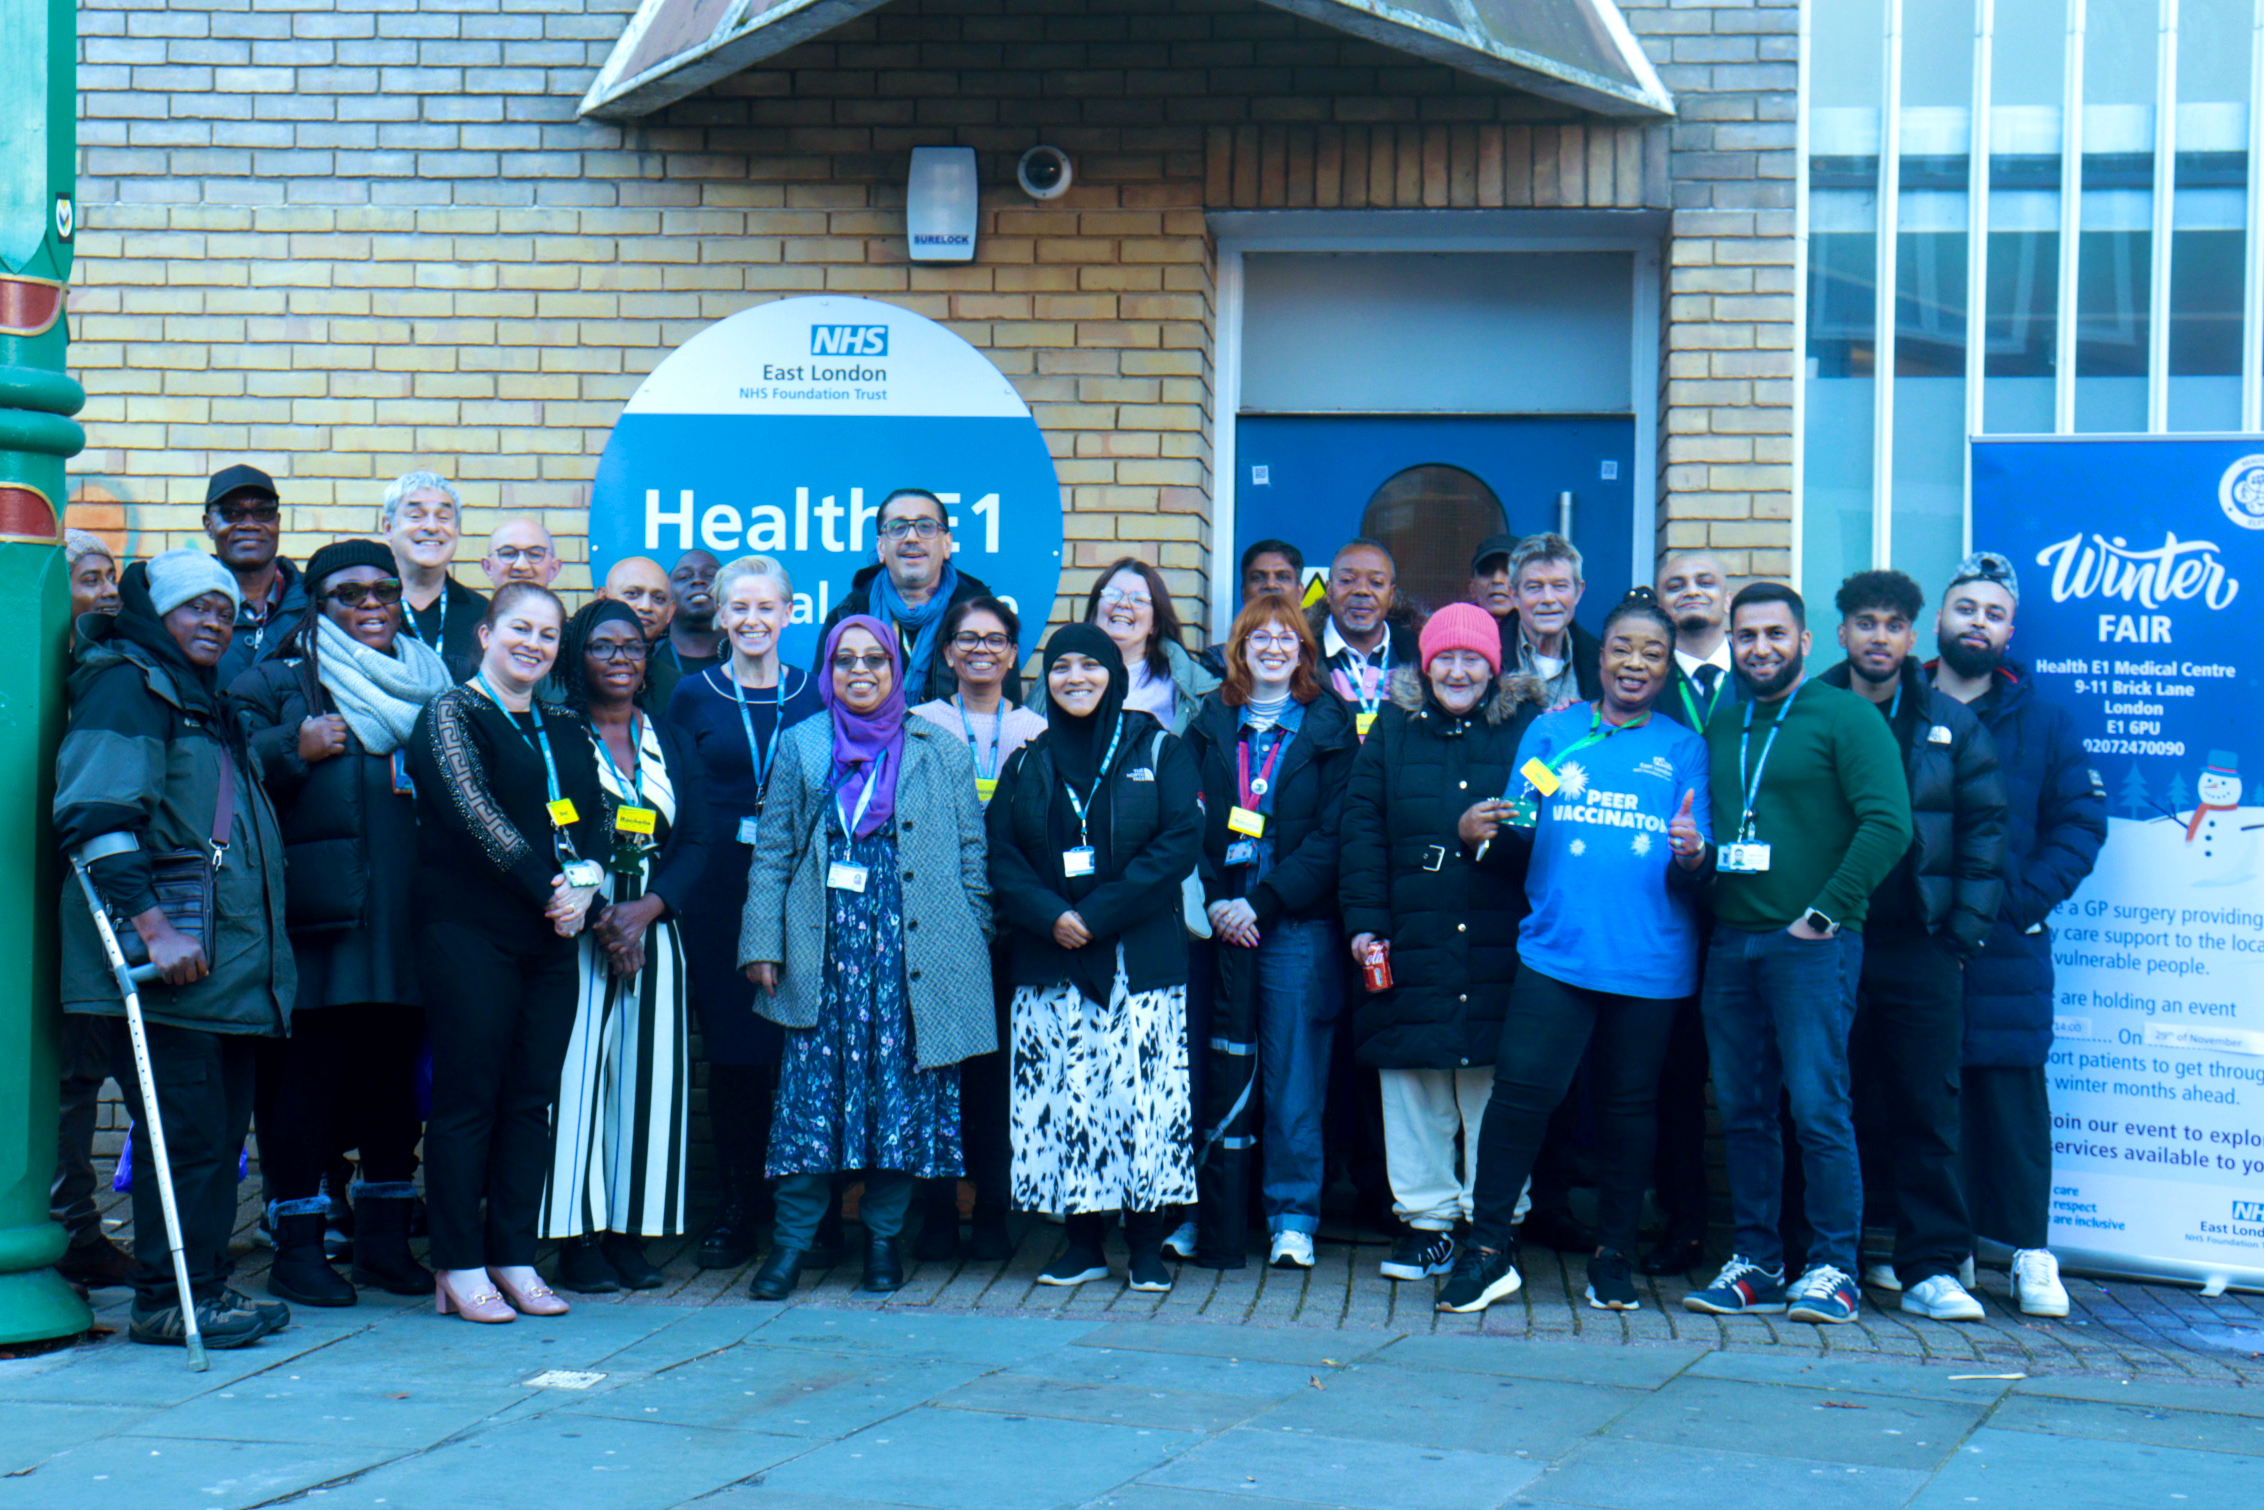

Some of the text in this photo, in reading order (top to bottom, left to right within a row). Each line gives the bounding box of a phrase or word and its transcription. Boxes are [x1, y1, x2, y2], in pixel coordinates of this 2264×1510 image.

[914, 234, 969, 245] SURELOCK
[812, 326, 887, 355] NHS
[763, 363, 887, 382] East London
[739, 387, 888, 400] NHS Foundation Trust
[645, 486, 880, 552] Health
[2035, 530, 2239, 610] Winter
[2098, 614, 2173, 644] FAIR
[2036, 658, 2236, 678] Health E1 Medical Centre
[2074, 679, 2195, 697] 9-11 Brick Lane
[2104, 699, 2164, 716] London
[2107, 719, 2161, 736] E1 6PU
[2083, 738, 2185, 757] 02072470090
[1586, 788, 1639, 811] PEER
[2068, 902, 2079, 915] a
[2084, 899, 2109, 917] GP
[2113, 903, 2177, 925] surgery
[2181, 907, 2263, 931] providing
[2064, 927, 2099, 942] care
[2104, 929, 2169, 949] support
[2175, 933, 2192, 949] to
[2198, 931, 2226, 951] the
[2054, 949, 2210, 978] vulnerable people.
[2060, 989, 2237, 1018] are holding an event
[2118, 1028, 2143, 1046] On
[2189, 1033, 2242, 1048] November
[2079, 1052, 2147, 1072] patients
[2152, 1058, 2170, 1073] to
[2175, 1061, 2203, 1080] get
[2054, 1074, 2241, 1106] winter months ahead.
[2088, 1118, 2119, 1134] our
[2125, 1121, 2177, 1139] event
[2184, 1125, 2203, 1141] to
[2124, 1146, 2209, 1168] available
[2216, 1153, 2236, 1170] to
[2053, 1185, 2079, 1197] care
[2053, 1199, 2098, 1214] respect
[2053, 1215, 2126, 1231] are inclusive
[2200, 1220, 2228, 1234] East
[2185, 1233, 2204, 1243] NHS
[2206, 1235, 2259, 1249] Foundation
